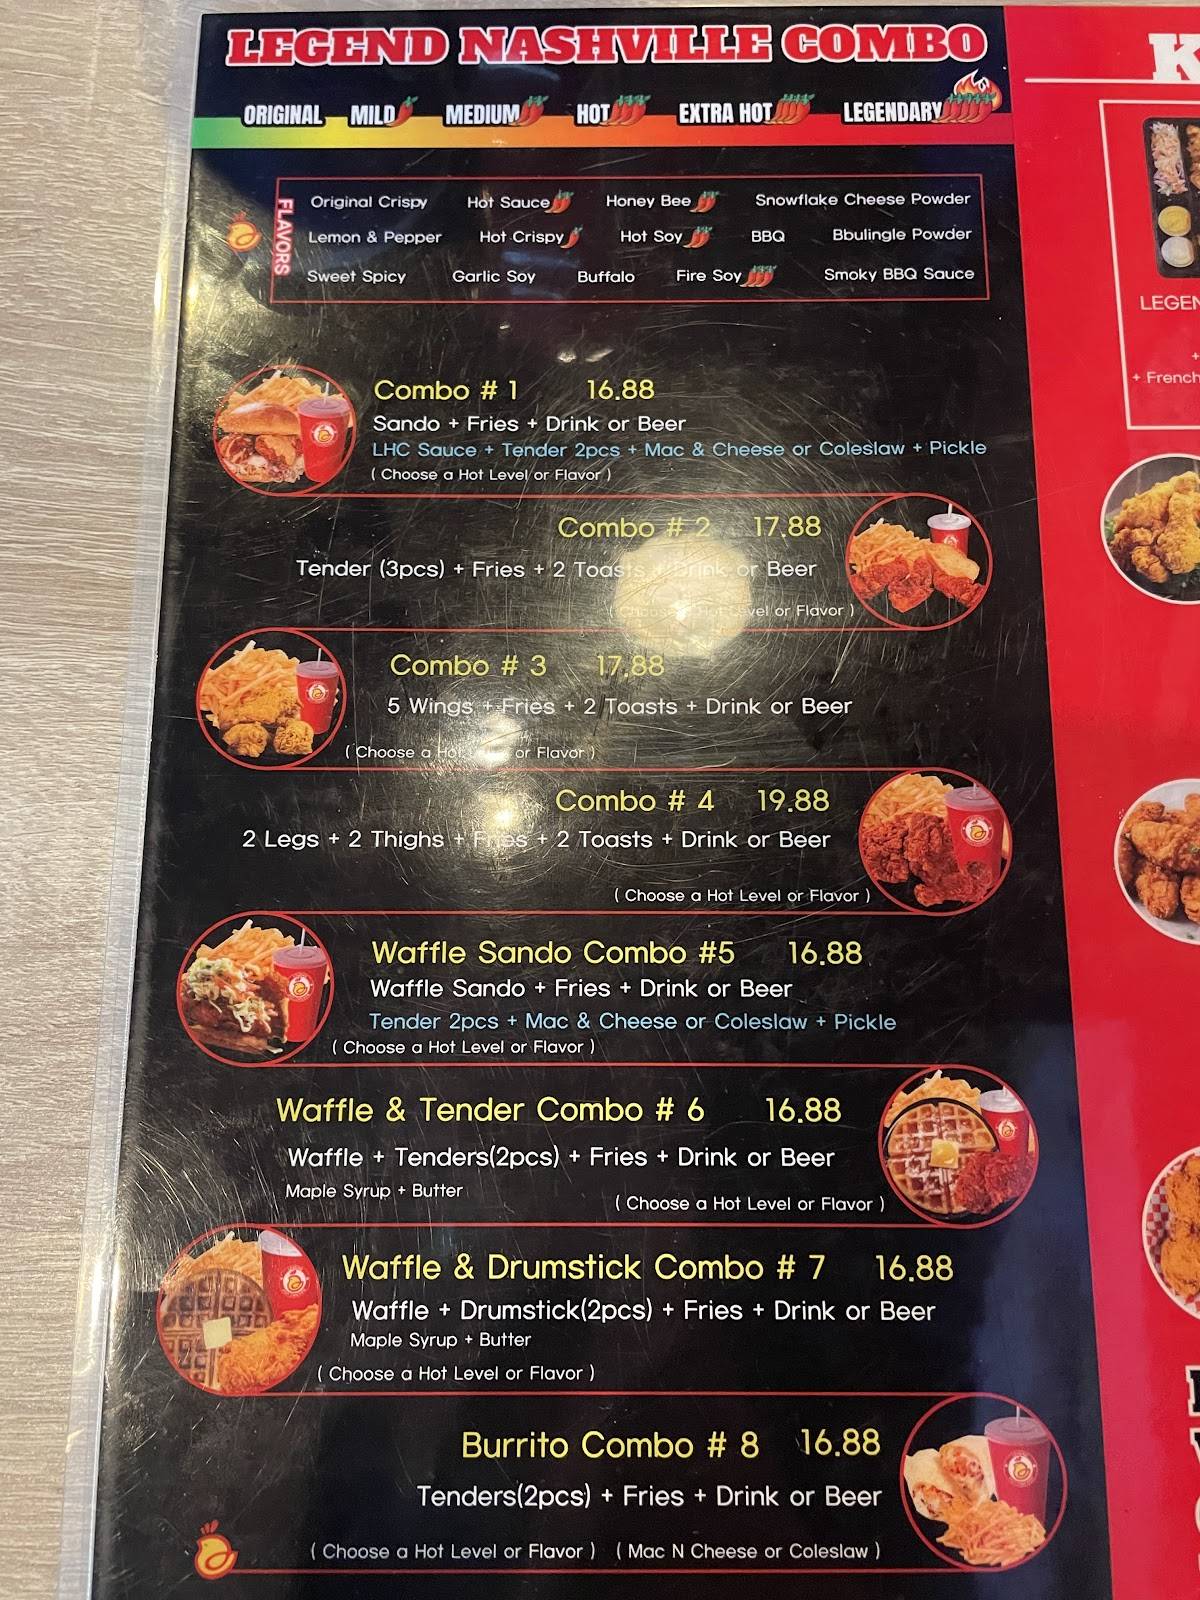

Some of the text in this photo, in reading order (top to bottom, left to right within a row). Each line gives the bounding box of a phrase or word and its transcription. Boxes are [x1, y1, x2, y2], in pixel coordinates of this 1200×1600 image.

[225, 24, 987, 66] LEGEND NASHVILLE COMBO
[244, 105, 323, 124] ORIGINAL
[351, 105, 396, 125] MILD
[446, 104, 520, 124] MEDIUM
[577, 104, 610, 124] HOT
[679, 102, 773, 123] EXTRA HOT
[844, 102, 943, 122] LEGENDARY
[311, 196, 428, 210] Original Crispy
[468, 196, 550, 209] Hot Sauce
[607, 195, 691, 208] Honey Bee
[756, 193, 971, 206] Snowflake Cheese Powder
[274, 198, 293, 276] FLAVORS
[309, 232, 442, 245] Lemon Pepper
[480, 231, 564, 245] Hot Crispy
[621, 230, 683, 245] Hot Soy
[752, 231, 785, 244] BBQ
[833, 228, 972, 242] Bbulingle Powder
[308, 270, 406, 285] Sweet Spicy
[453, 270, 536, 284] Garlic Soy
[579, 270, 635, 283] Buffalo
[677, 270, 742, 284] Fire Soy
[824, 267, 975, 282] Smoky BBQ Sauce
[374, 379, 517, 400] Combo 1
[587, 379, 655, 400] 16.88
[373, 416, 686, 432] Sando Fries Drink Beer
[372, 441, 987, 459] LHC Sauce Tender 2pcs Mac Cheese Coleslaw Pickle
[381, 468, 601, 481] Choose Hot Level Flavor
[558, 517, 710, 537] Combo 2
[754, 516, 821, 537] 17.88
[296, 560, 371, 577] Tender
[380, 559, 445, 580] (3pcs)
[473, 561, 525, 578] Fries
[554, 561, 565, 578] 2
[574, 562, 645, 578] Toasts
[768, 561, 817, 577] Beer
[797, 604, 844, 617] Flavor
[390, 654, 546, 676] Combo 3
[598, 656, 664, 677] 17.88
[409, 697, 851, 716] Wings Fries Toasts Drink Beer
[556, 789, 714, 812] Combo 4
[758, 789, 830, 813] 19.88
[265, 830, 319, 850] Legs
[371, 830, 444, 850] Thighs
[579, 831, 653, 848] Toasts
[681, 831, 738, 848] Drink
[779, 831, 831, 848] Beer
[625, 888, 859, 902] Choose Hot Level Flavor
[372, 940, 735, 964] Waffle Sando Combo #5
[789, 941, 863, 966] 16.88
[370, 979, 793, 997] Waffle Sando Fries Drink Beer
[369, 1013, 897, 1032] Tender 2pcs Mac Cheese Coleslaw Pickle
[276, 1097, 704, 1122] Waffle Tender Combo 6
[765, 1098, 841, 1123] 16.88
[288, 1145, 835, 1169] Waffle Tenders(2pcs) Fries Drink Beer
[286, 1183, 463, 1200] Maple Syrup Butter
[627, 1196, 873, 1211] Choose Hot Level Flavor
[342, 1254, 825, 1280] Waffle Drumstick Combo 7
[875, 1255, 954, 1282] 16.88
[352, 1298, 936, 1323] Waffle Drumstick(2pcs) Fries Drink Beer
[351, 1333, 532, 1349] Maple Syrup Butter
[463, 1430, 759, 1458] Burrito Combo 8
[801, 1428, 881, 1457] 16.88
[417, 1483, 882, 1510] Tenders(2pcs) Fries Drink Beer
[628, 1544, 868, 1558] Mac Cheese Coleslaw
